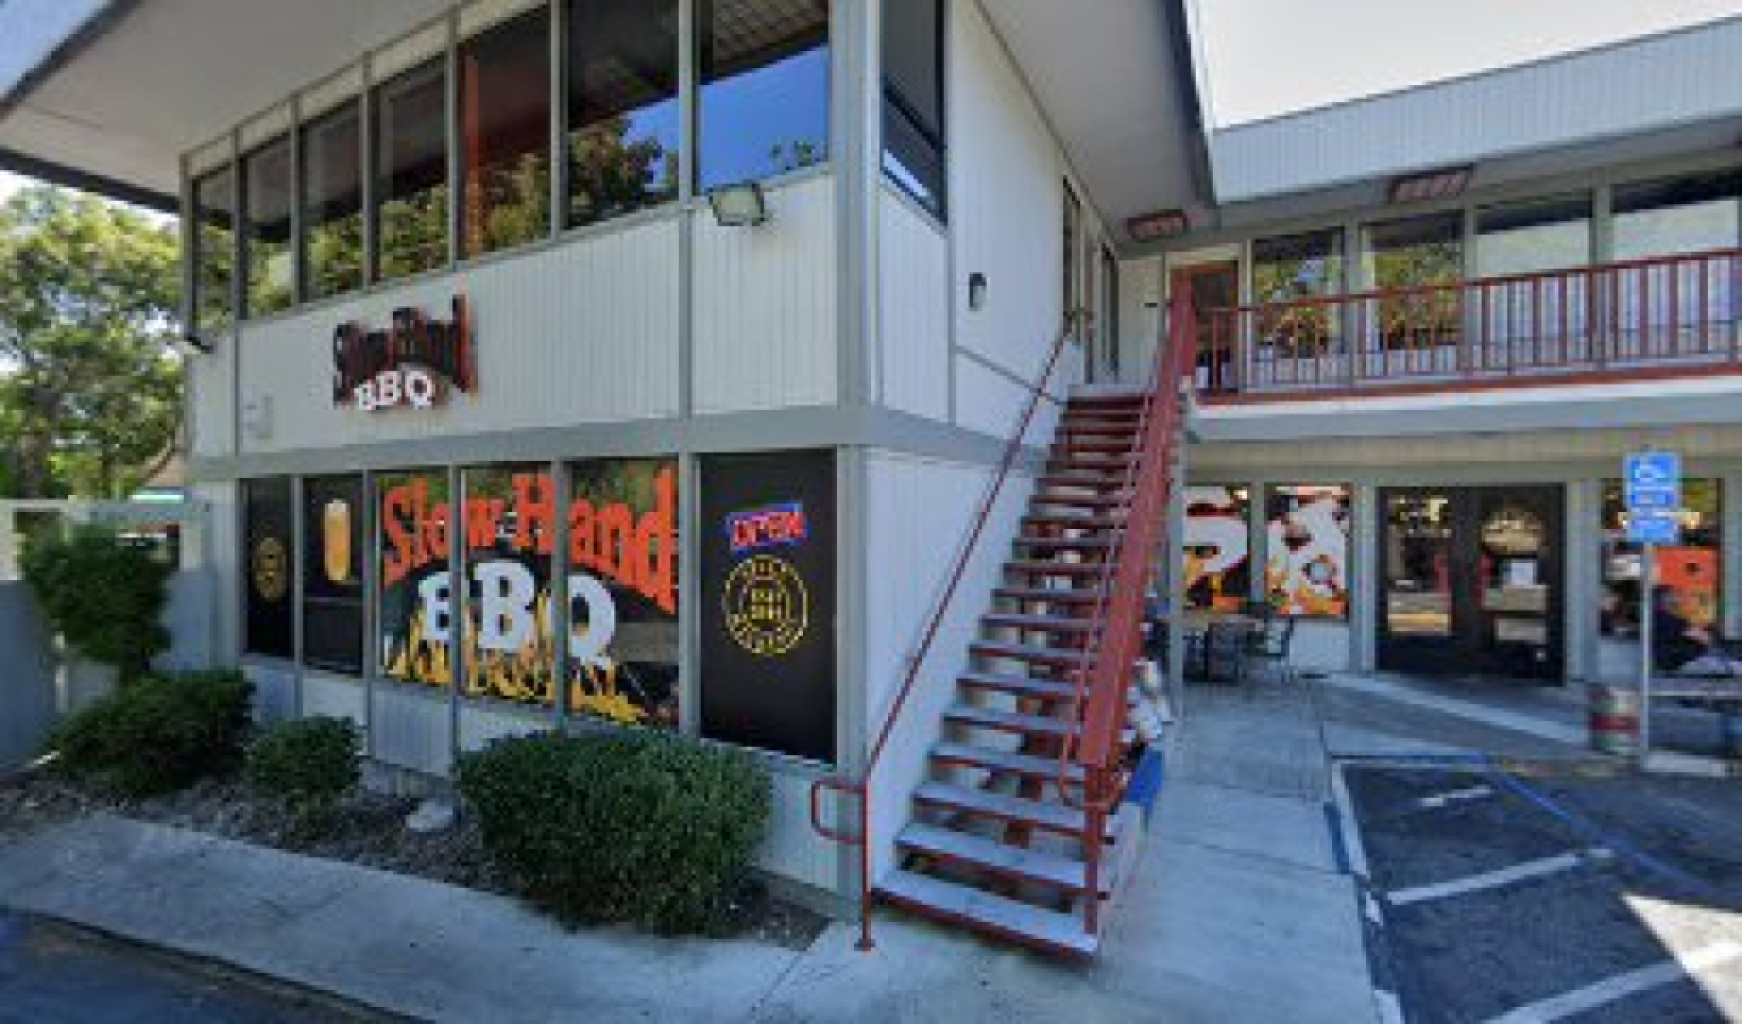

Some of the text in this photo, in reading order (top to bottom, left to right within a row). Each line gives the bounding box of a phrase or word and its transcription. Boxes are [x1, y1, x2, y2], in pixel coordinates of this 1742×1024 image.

[353, 368, 434, 411] BBQ
[382, 477, 504, 590] Slow
[511, 466, 677, 614] Hand
[733, 511, 804, 547] OPEN
[417, 560, 618, 671] BBQ
